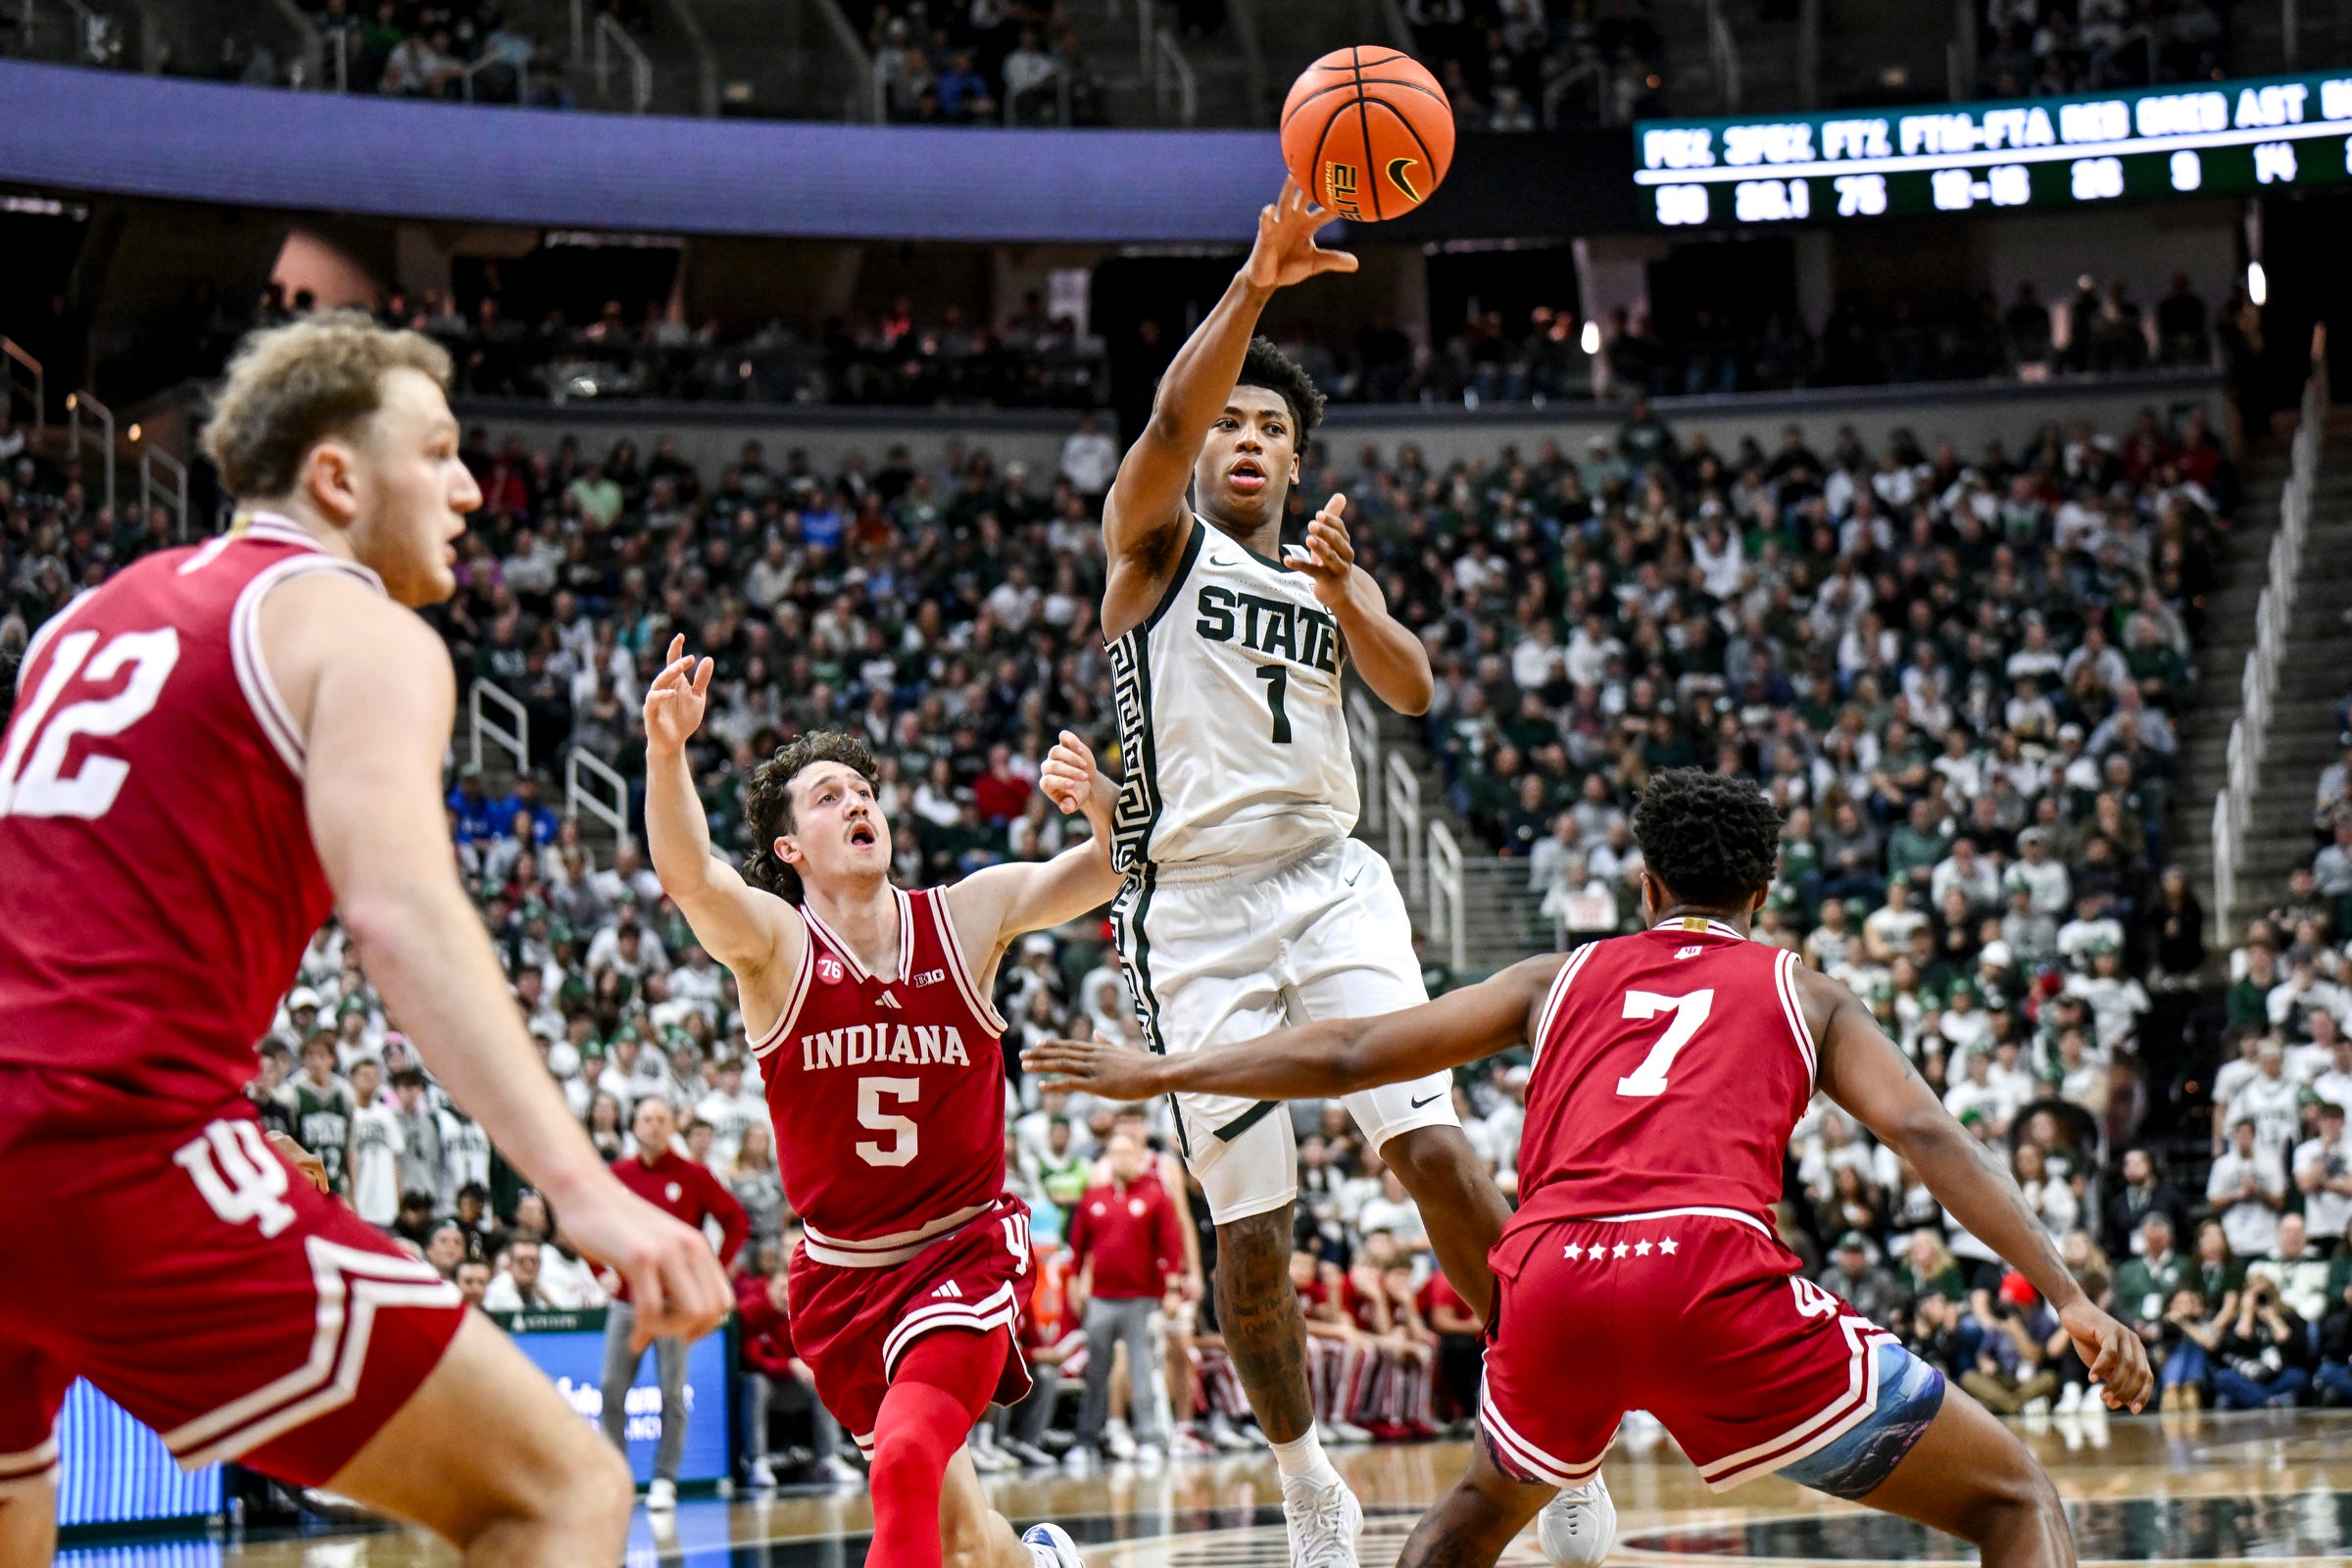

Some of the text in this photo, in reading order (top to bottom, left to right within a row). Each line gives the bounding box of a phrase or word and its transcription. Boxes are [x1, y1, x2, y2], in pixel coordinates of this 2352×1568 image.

[2234, 83, 2308, 129] AST
[2253, 141, 2297, 184] 14
[1196, 585, 1337, 675] STATE
[0, 626, 180, 821] 12
[1255, 664, 1293, 744] 1
[801, 1022, 971, 1072] INDIANA
[1616, 988, 1715, 1097] 7
[856, 1076, 920, 1168] 5
